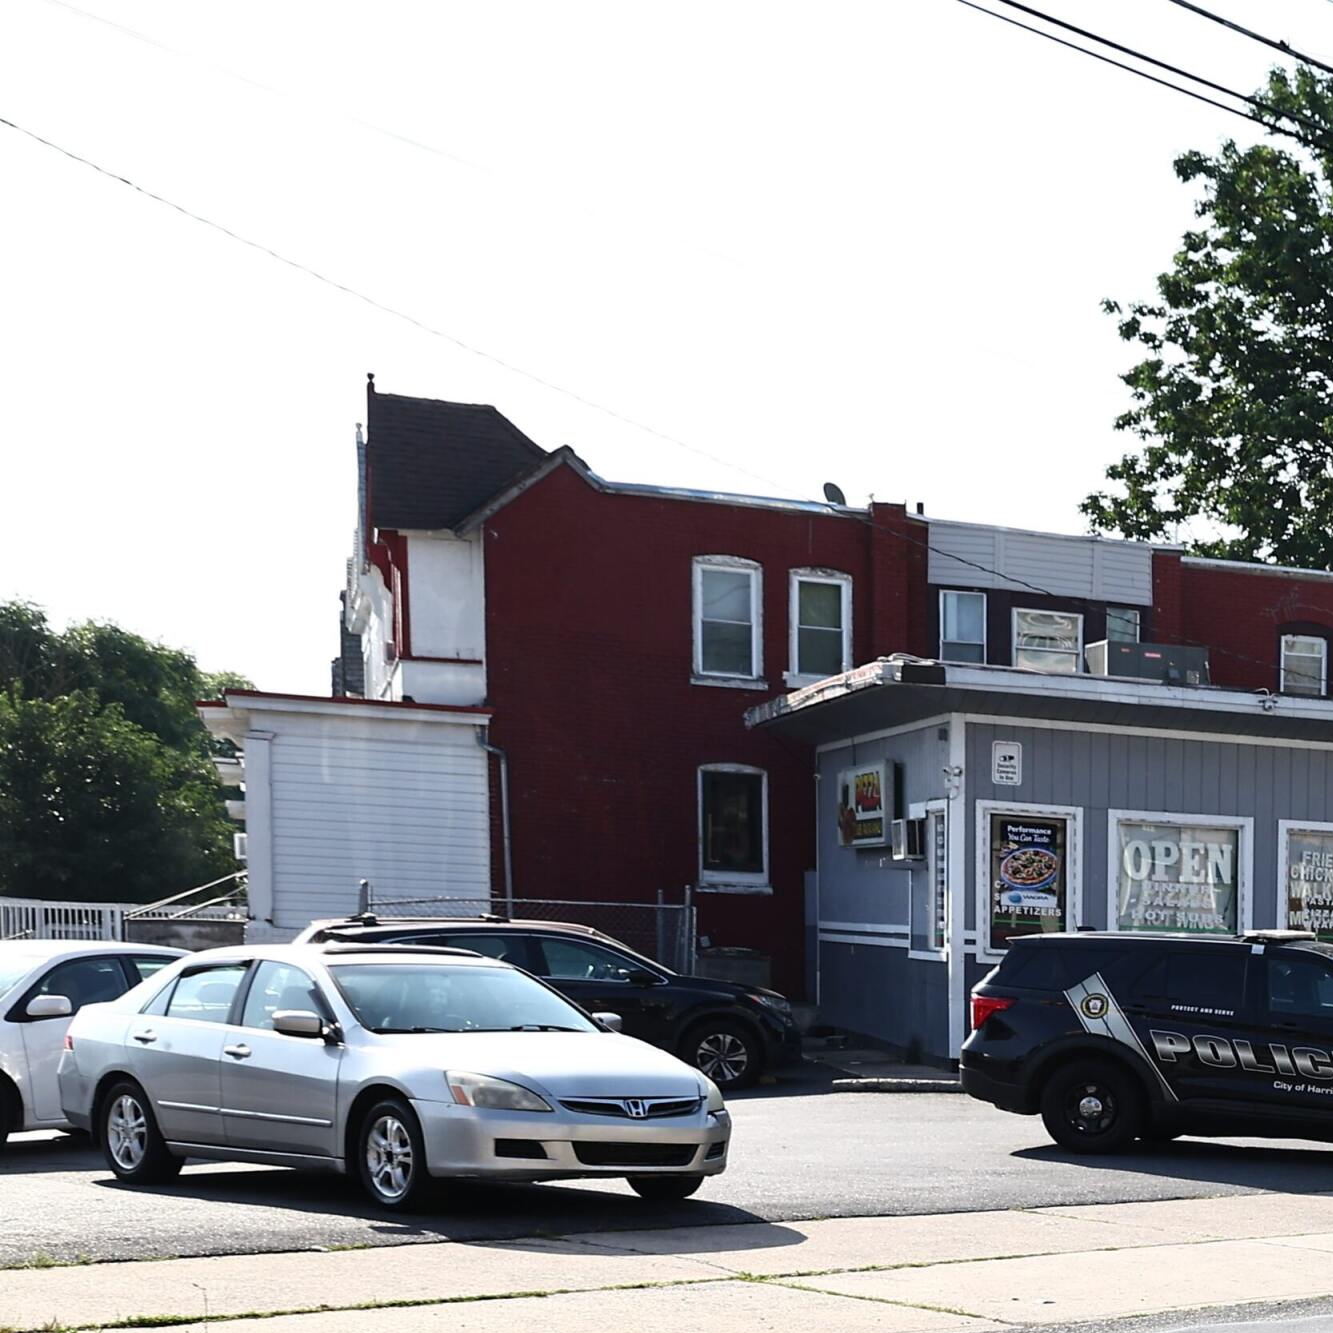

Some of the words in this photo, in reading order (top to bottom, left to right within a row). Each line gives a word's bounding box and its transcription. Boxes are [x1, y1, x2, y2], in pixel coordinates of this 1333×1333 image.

[1007, 824, 1052, 835] Performance
[1008, 833, 1019, 841] You
[1019, 834, 1032, 842] Can
[1123, 840, 1233, 884] OPEN
[993, 905, 1062, 917] APPETIZERS
[1171, 1004, 1199, 1013] PROTECT
[1200, 1006, 1214, 1014] AND
[1214, 1008, 1234, 1017] SERVE
[1273, 1081, 1294, 1093] City
[1295, 1083, 1305, 1092] of
